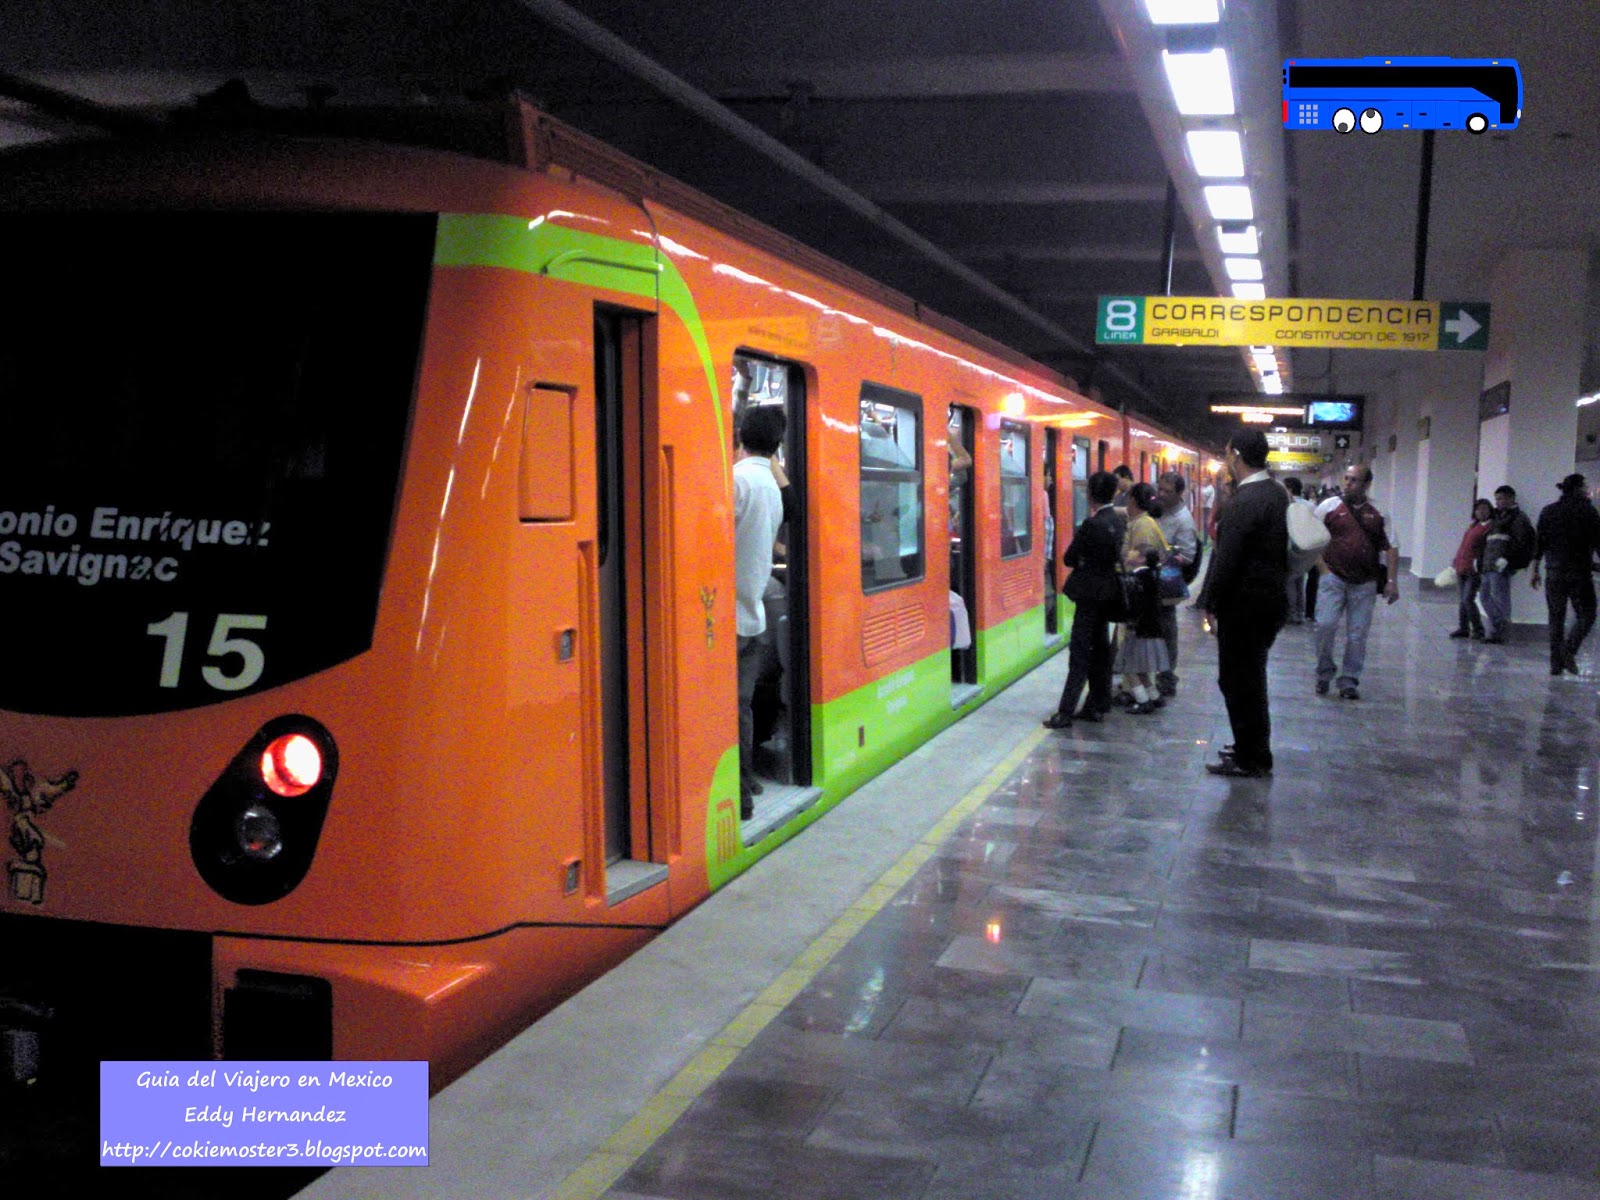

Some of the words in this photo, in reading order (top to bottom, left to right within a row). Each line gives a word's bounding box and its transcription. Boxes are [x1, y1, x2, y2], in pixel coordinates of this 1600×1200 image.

[1106, 300, 1137, 331] 8
[1152, 303, 1432, 324] CORRESPONDENCIA
[1103, 331, 1137, 340] LINEA
[1151, 328, 1219, 338] GARIBALDI
[1275, 329, 1373, 341] CONSTITUCION
[1377, 332, 1397, 342] DE
[1402, 332, 1430, 342] 1917
[1266, 435, 1322, 447] SALIDA
[0, 541, 179, 586] Savignac
[147, 611, 268, 691] 15
